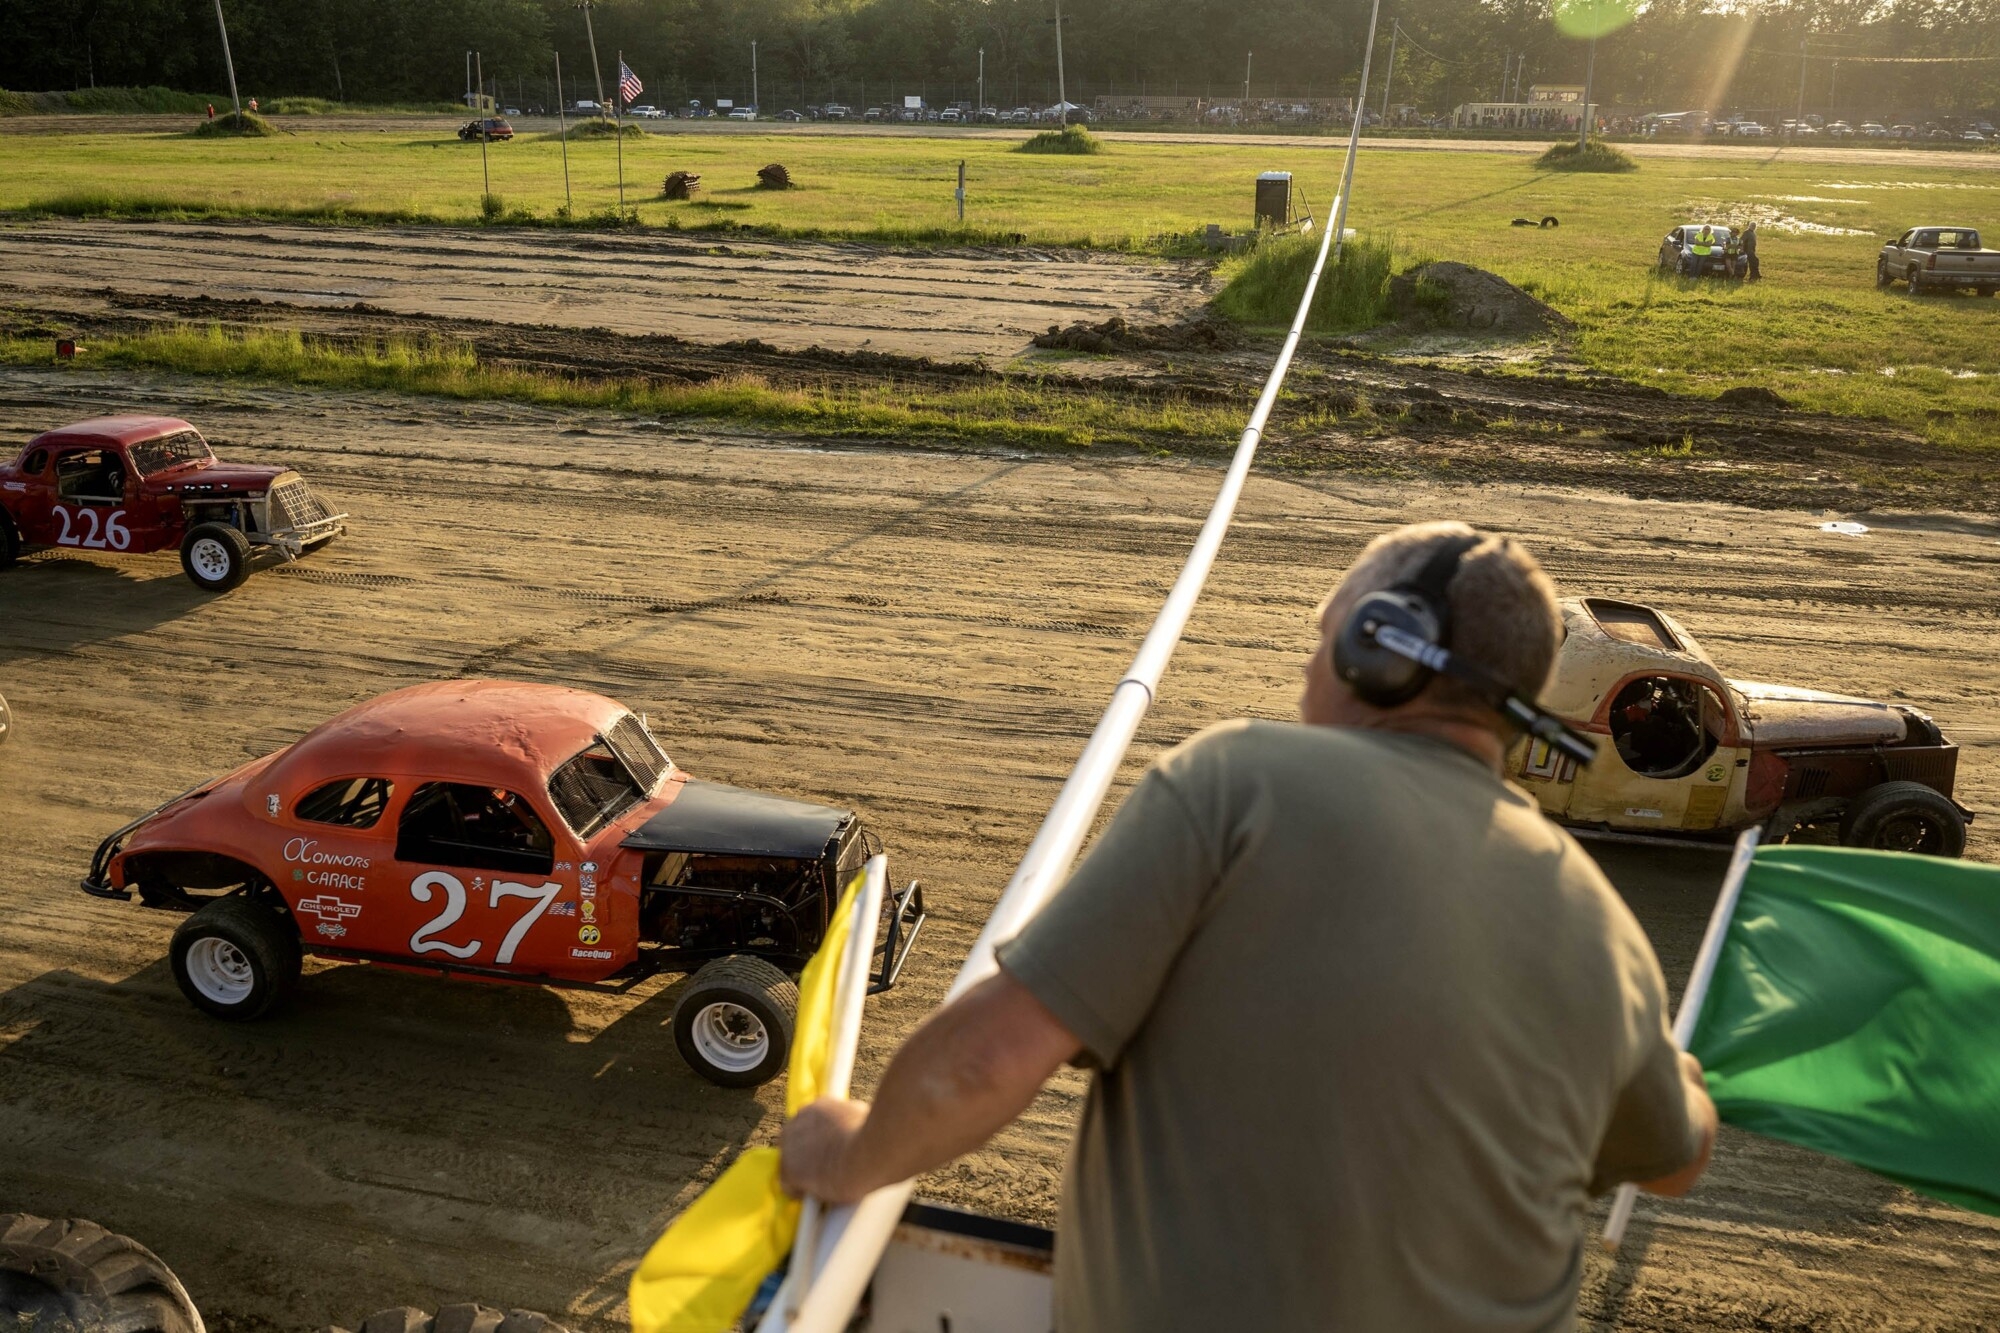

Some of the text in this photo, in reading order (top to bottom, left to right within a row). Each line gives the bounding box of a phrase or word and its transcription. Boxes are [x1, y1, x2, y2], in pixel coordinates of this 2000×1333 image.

[52, 505, 131, 549] 226
[303, 902, 357, 914] CHEVROLET
[410, 870, 563, 964] 27
[572, 948, 612, 959] RaceQuip
